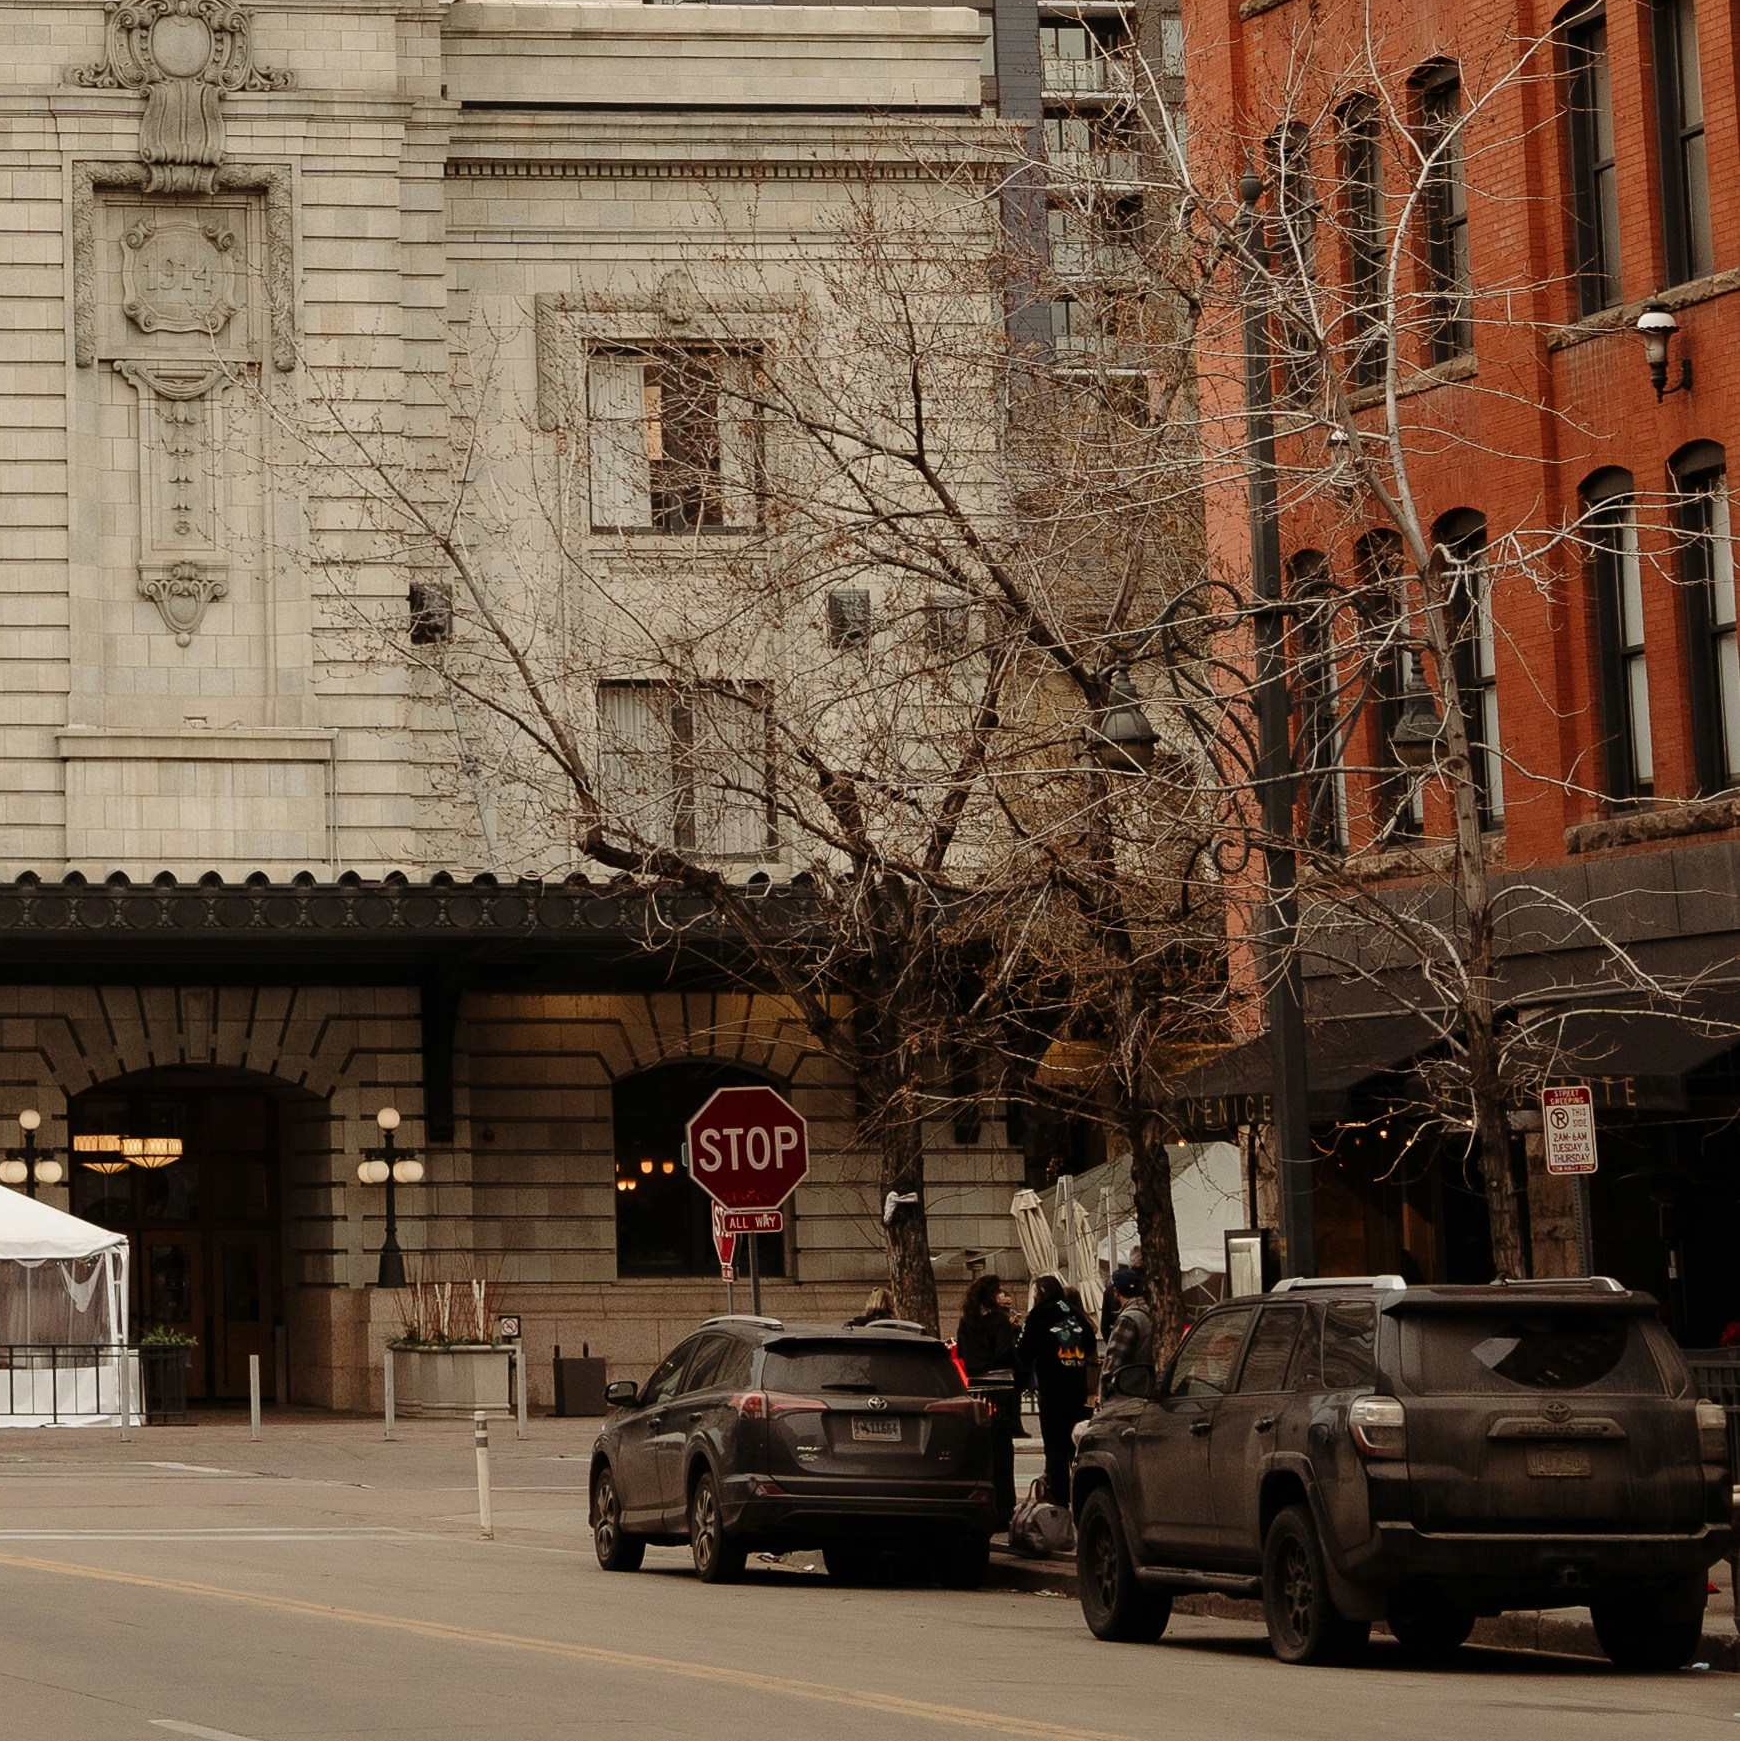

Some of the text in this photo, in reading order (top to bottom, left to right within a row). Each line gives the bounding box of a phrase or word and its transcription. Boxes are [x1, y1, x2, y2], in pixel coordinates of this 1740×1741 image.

[1186, 1094, 1272, 1125] VENICE
[1572, 1108, 1587, 1117] THIS
[1573, 1118, 1588, 1128] SIDE
[698, 1126, 799, 1173] STOP
[1552, 1142, 1584, 1153] TUESDAY
[1553, 1153, 1591, 1164] THURSDAY
[729, 1215, 776, 1229] ALL WAY
